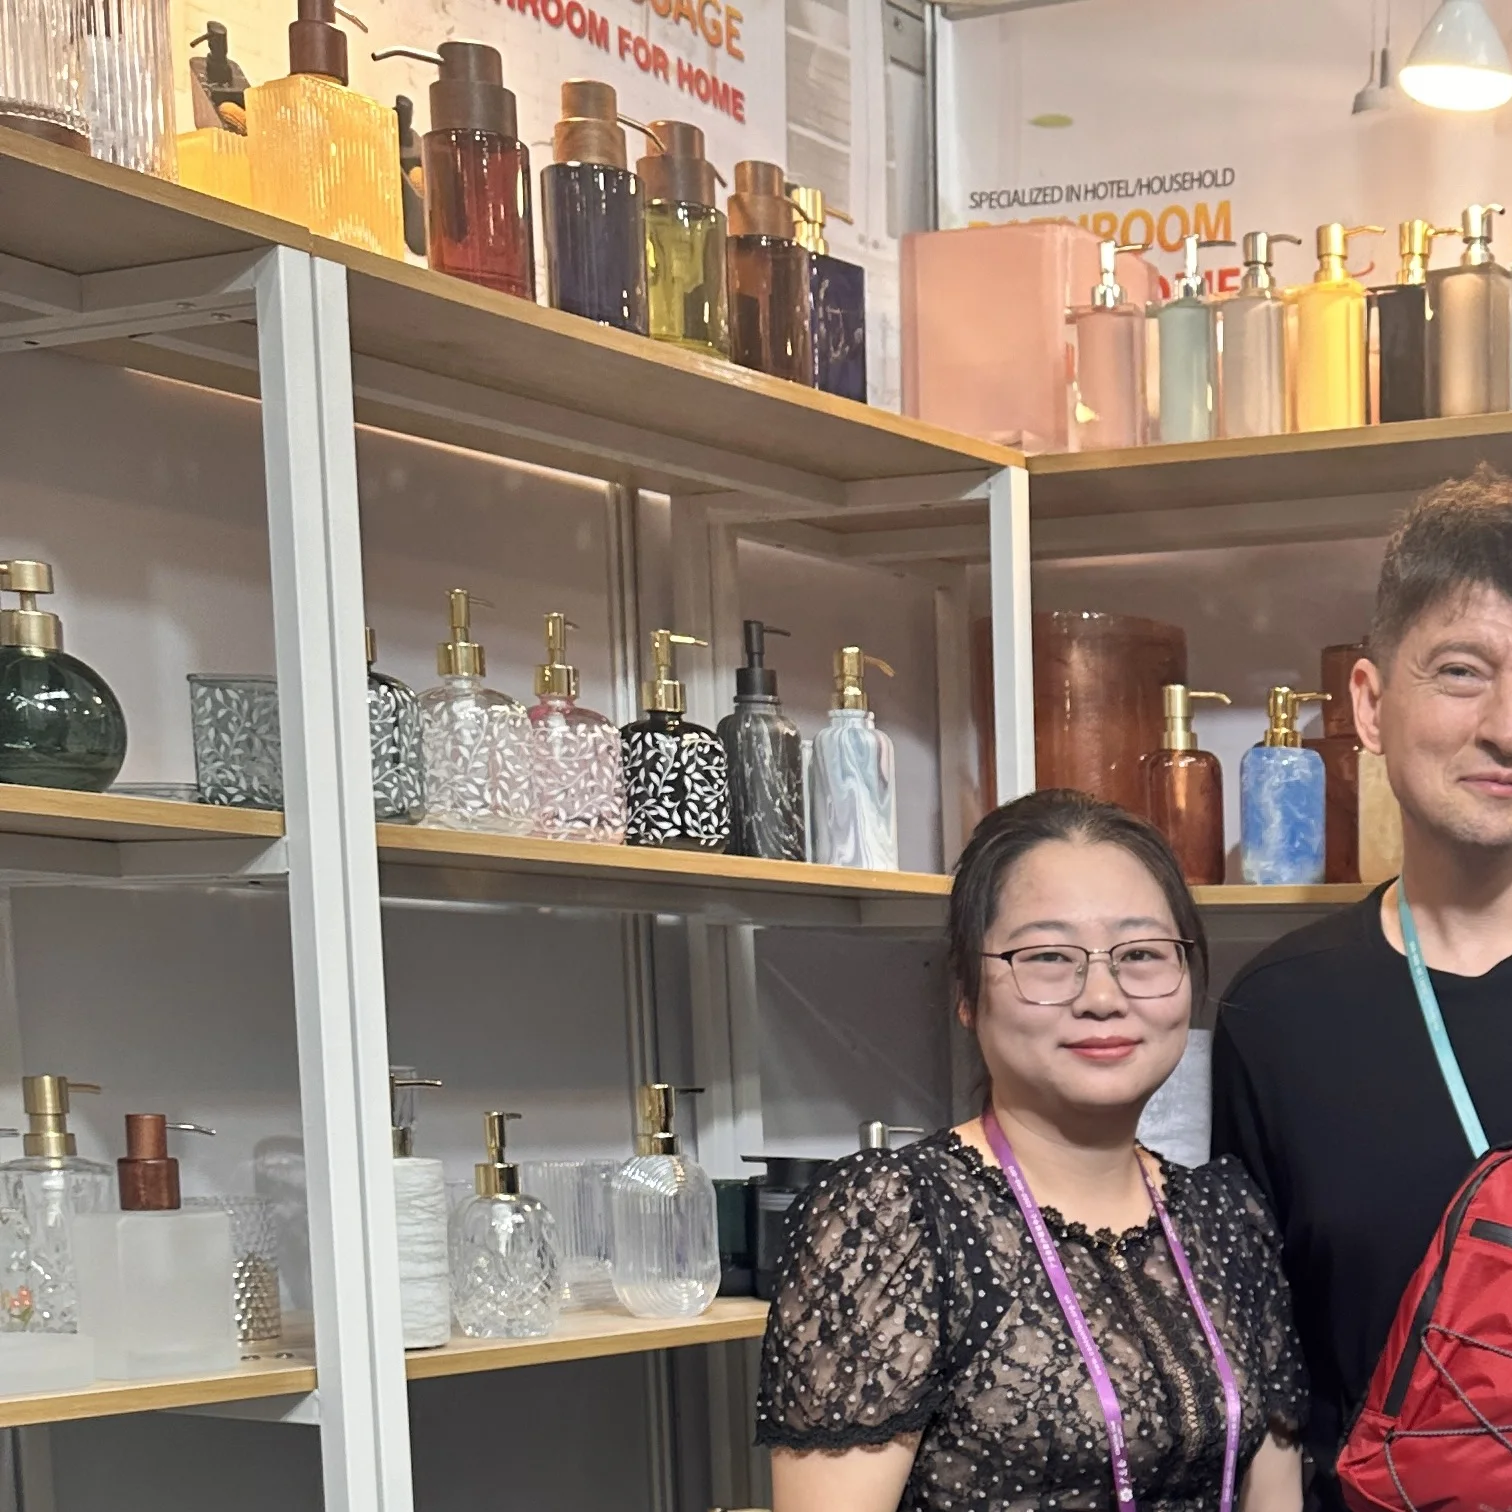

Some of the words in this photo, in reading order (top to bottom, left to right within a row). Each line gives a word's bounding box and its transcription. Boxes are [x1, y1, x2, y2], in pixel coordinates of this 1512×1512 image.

[617, 26, 670, 84] FOR
[677, 57, 746, 124] HOME
[969, 185, 1063, 209] SPECIALIZED
[1065, 184, 1083, 202] IN
[1084, 167, 1236, 200] HOTEL/HOUSEHOLD
